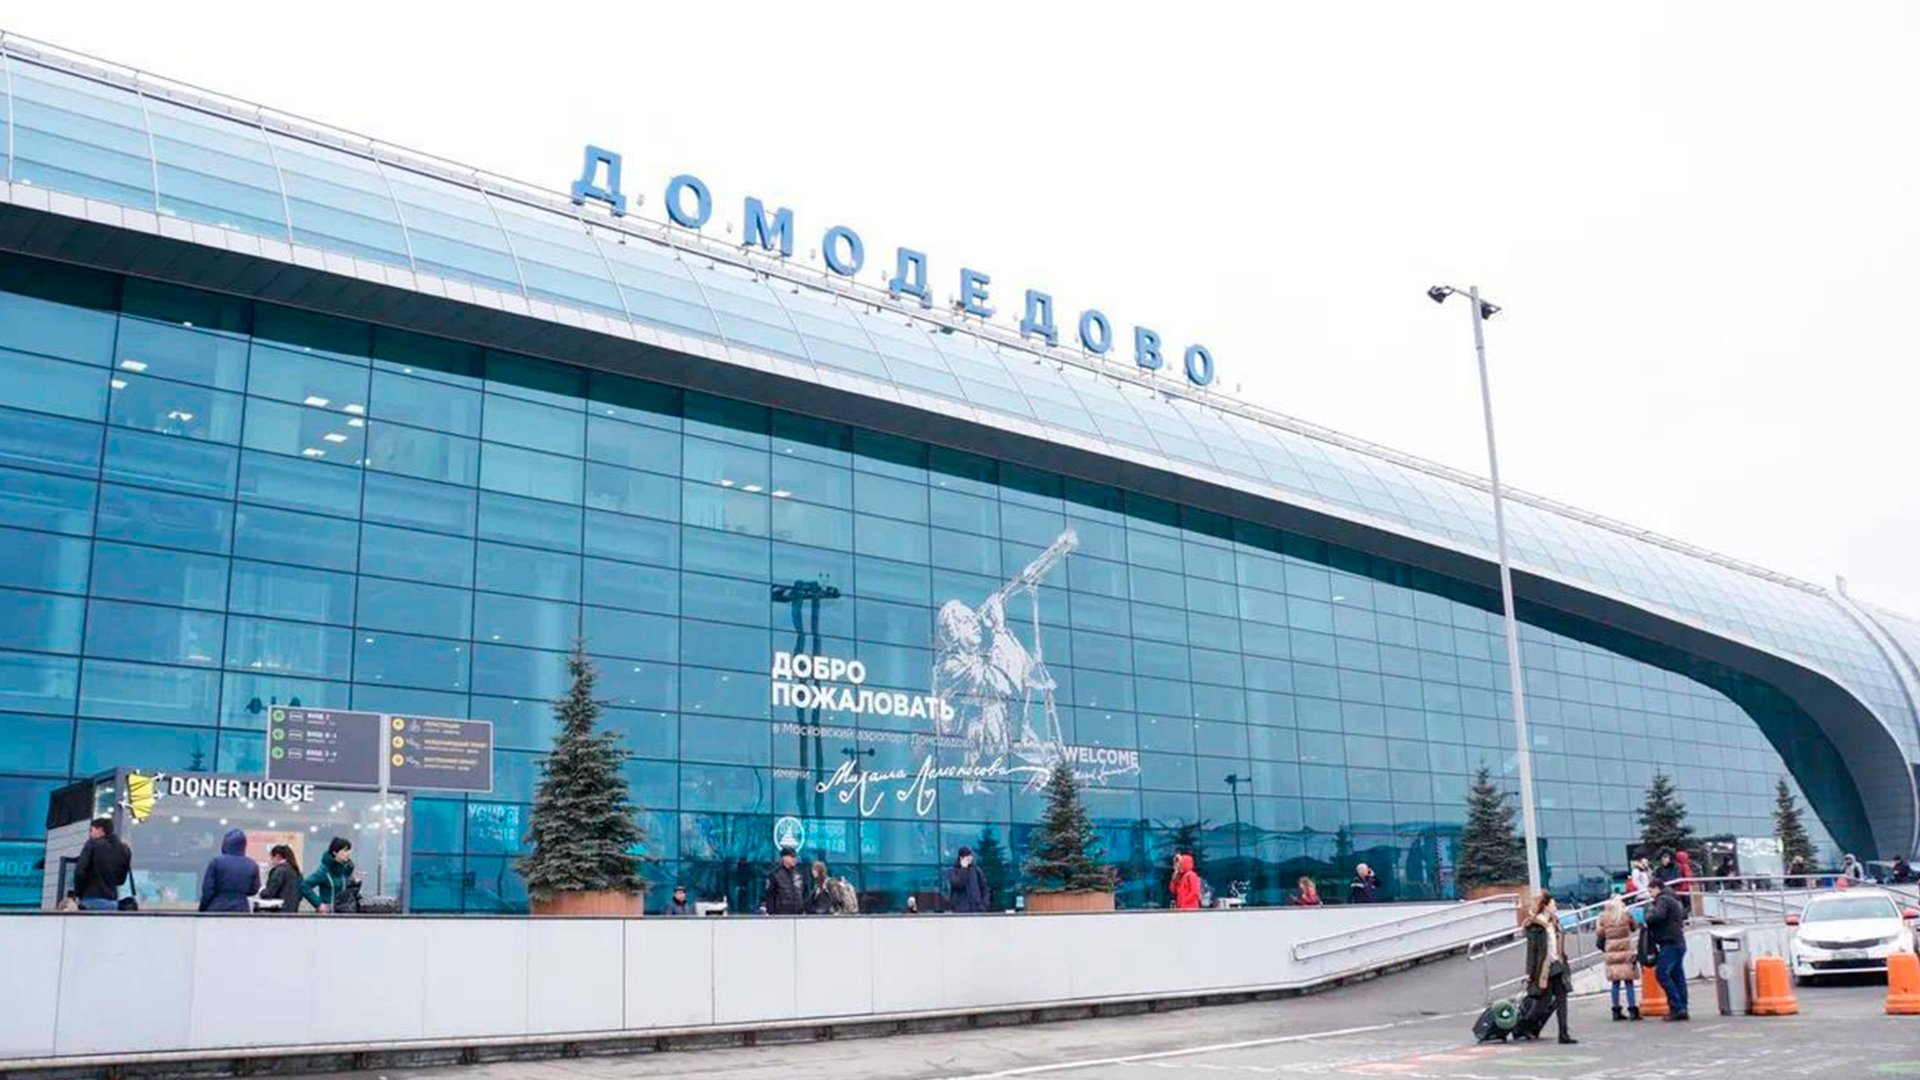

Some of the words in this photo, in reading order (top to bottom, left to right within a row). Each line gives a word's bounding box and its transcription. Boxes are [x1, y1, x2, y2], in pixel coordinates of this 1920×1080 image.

[571, 144, 1214, 386] ДОМОДЕДОВО
[772, 651, 866, 684] ДОБРО
[772, 681, 955, 721] ПОЖАЛОВАТЬ
[783, 723, 854, 740] Московский
[1062, 746, 1139, 767] WELCOME
[169, 776, 241, 798] DONER
[248, 780, 315, 802] HOUSE
[815, 759, 907, 817] Михаила
